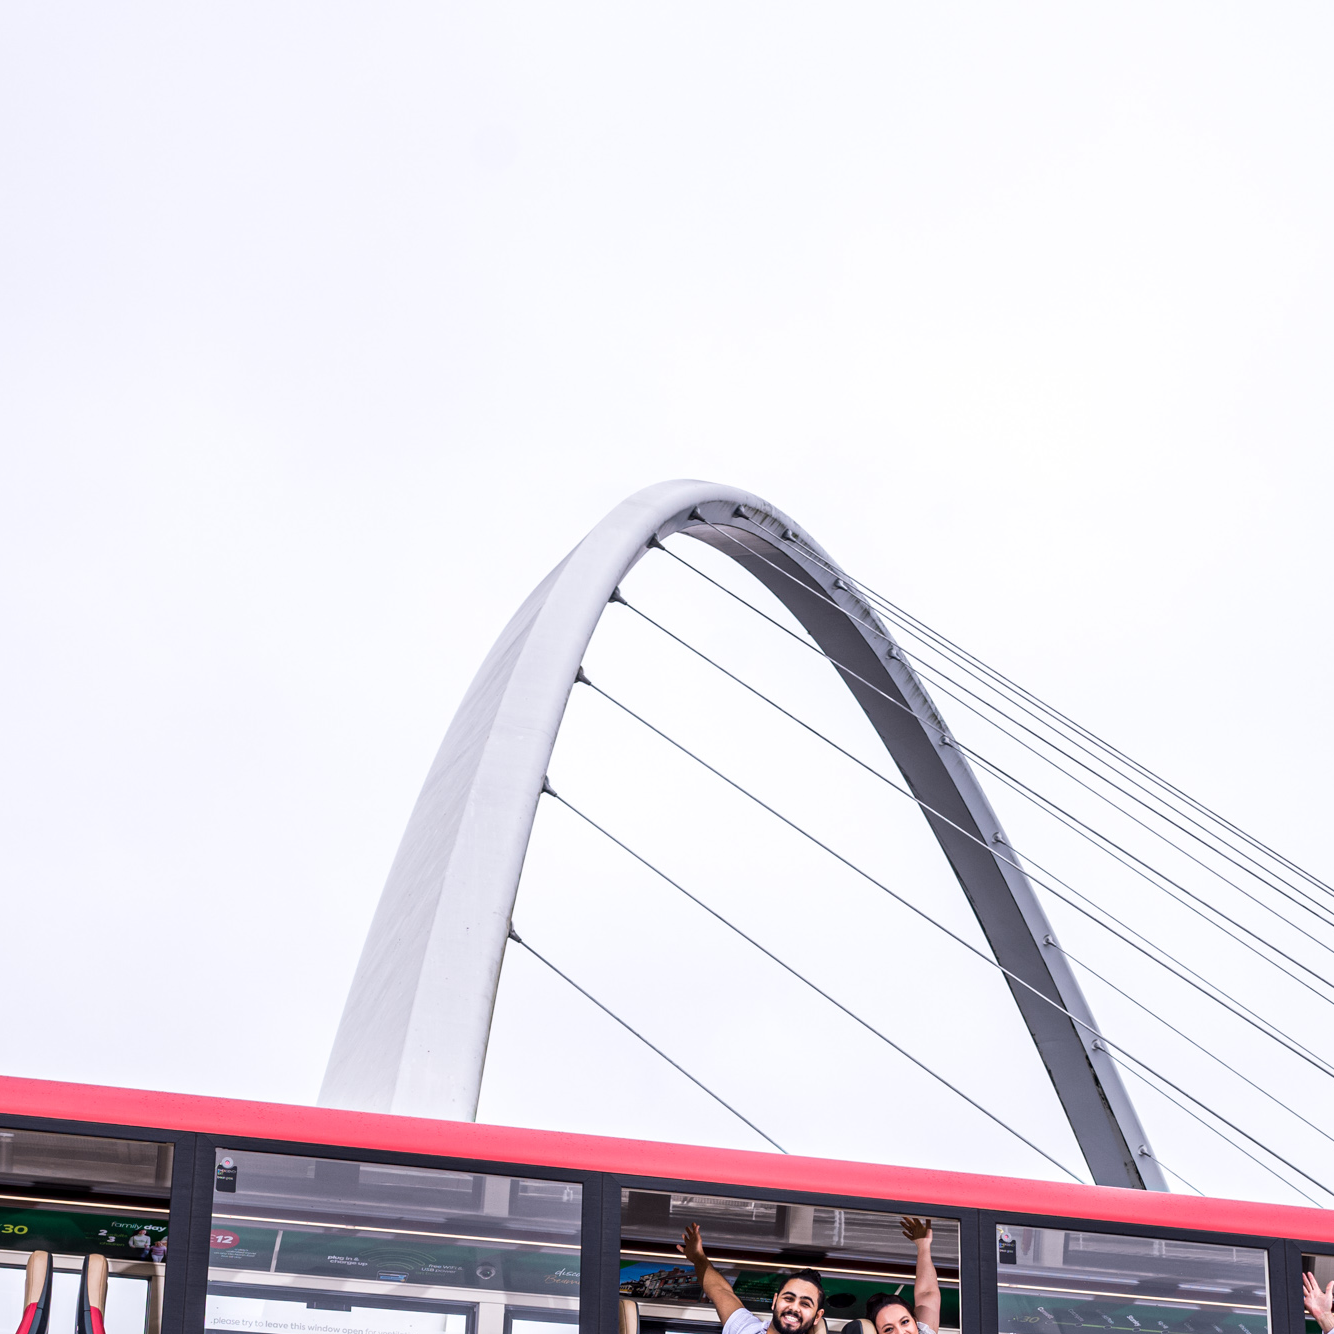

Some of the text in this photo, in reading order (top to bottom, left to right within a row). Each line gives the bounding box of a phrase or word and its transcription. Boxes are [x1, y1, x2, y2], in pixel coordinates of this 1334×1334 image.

[143, 1224, 167, 1233] day
[213, 1317, 241, 1327] please
[242, 1318, 254, 1328] try
[254, 1319, 264, 1327] to
[265, 1320, 289, 1329] leave
[290, 1322, 306, 1331] this
[308, 1324, 341, 1333] window
